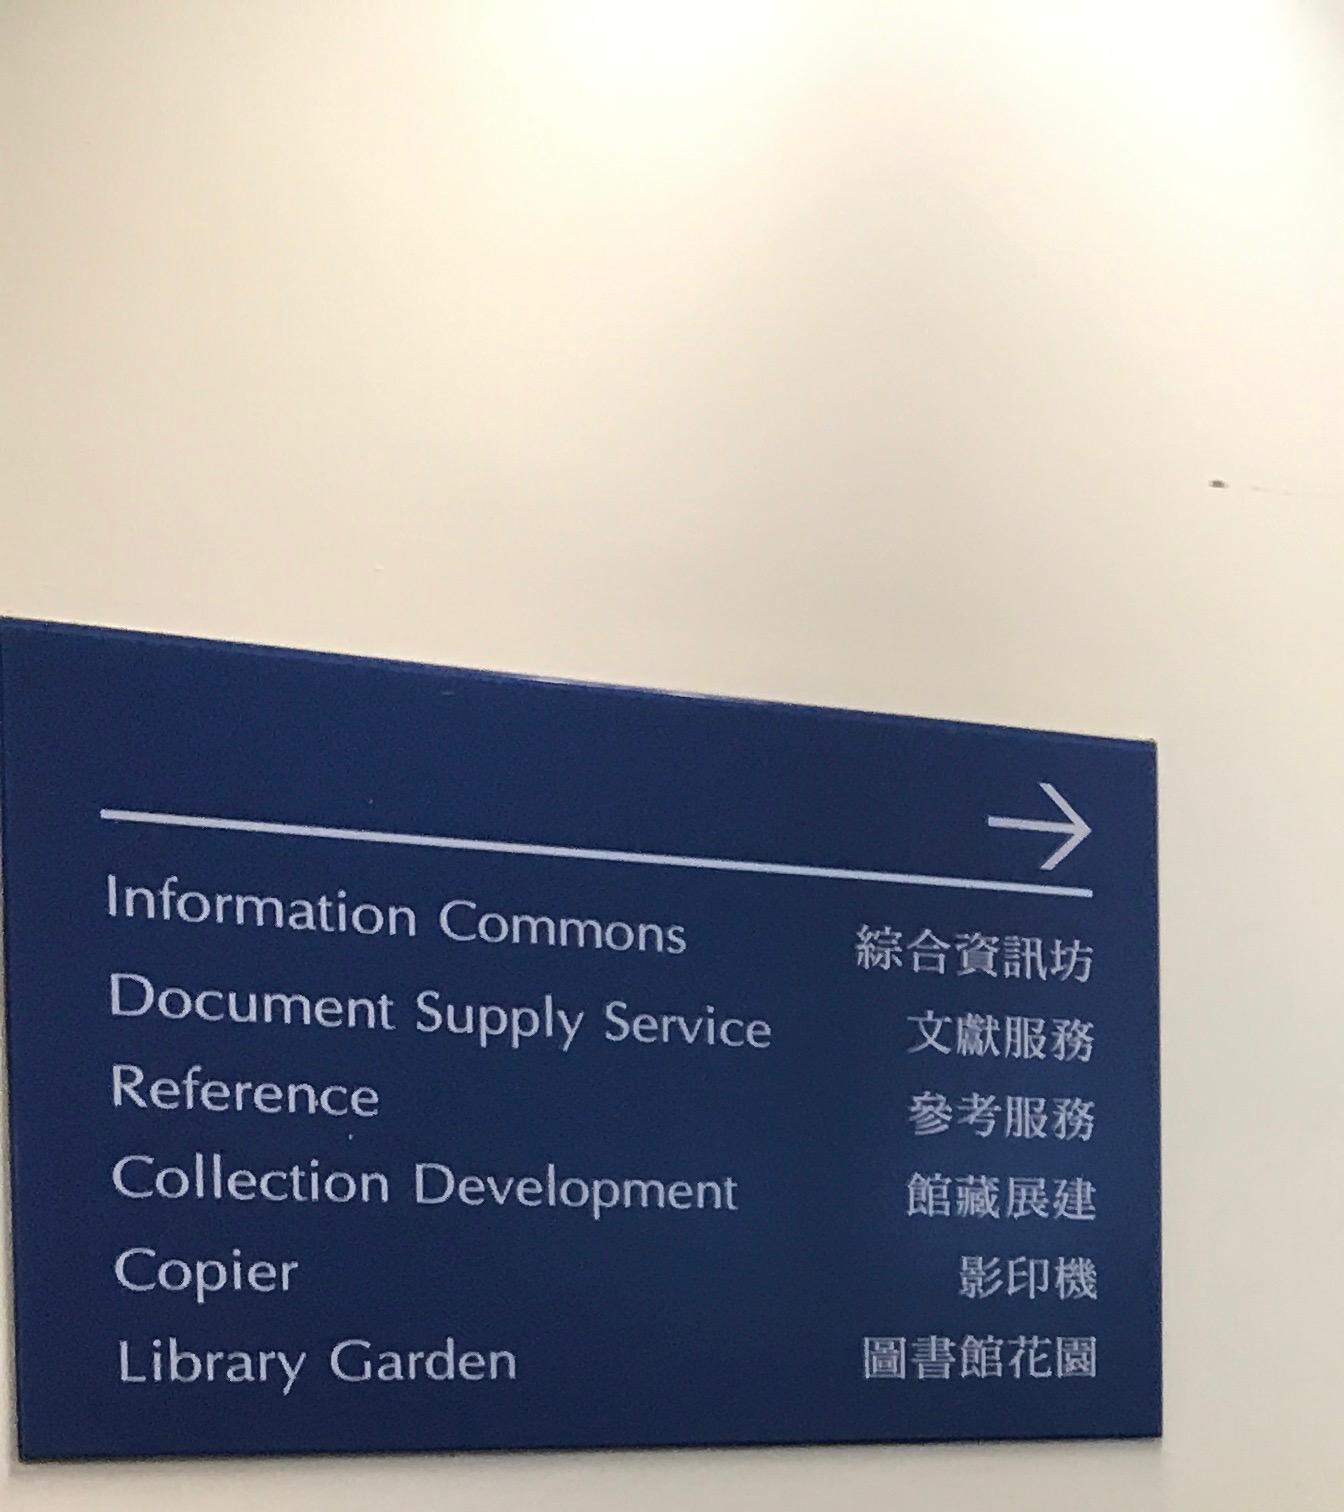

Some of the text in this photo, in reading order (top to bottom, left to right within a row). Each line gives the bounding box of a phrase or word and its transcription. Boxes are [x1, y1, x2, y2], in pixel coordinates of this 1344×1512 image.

[109, 875, 685, 953] Information Commons
[857, 923, 1092, 983] 綜合資訊坊
[111, 974, 770, 1050] Document Supply Service
[907, 1009, 1093, 1062] 文獻服務
[113, 1065, 378, 1116] Reference
[909, 1090, 1093, 1141] 參考服務
[113, 1153, 736, 1219] Collection Development
[908, 1171, 1095, 1220] 館藏展建
[115, 1249, 298, 1303] Copier
[961, 1255, 1097, 1300] 影印機
[121, 1338, 515, 1394] Library Garden
[864, 1333, 1096, 1380] 圖書館花園
